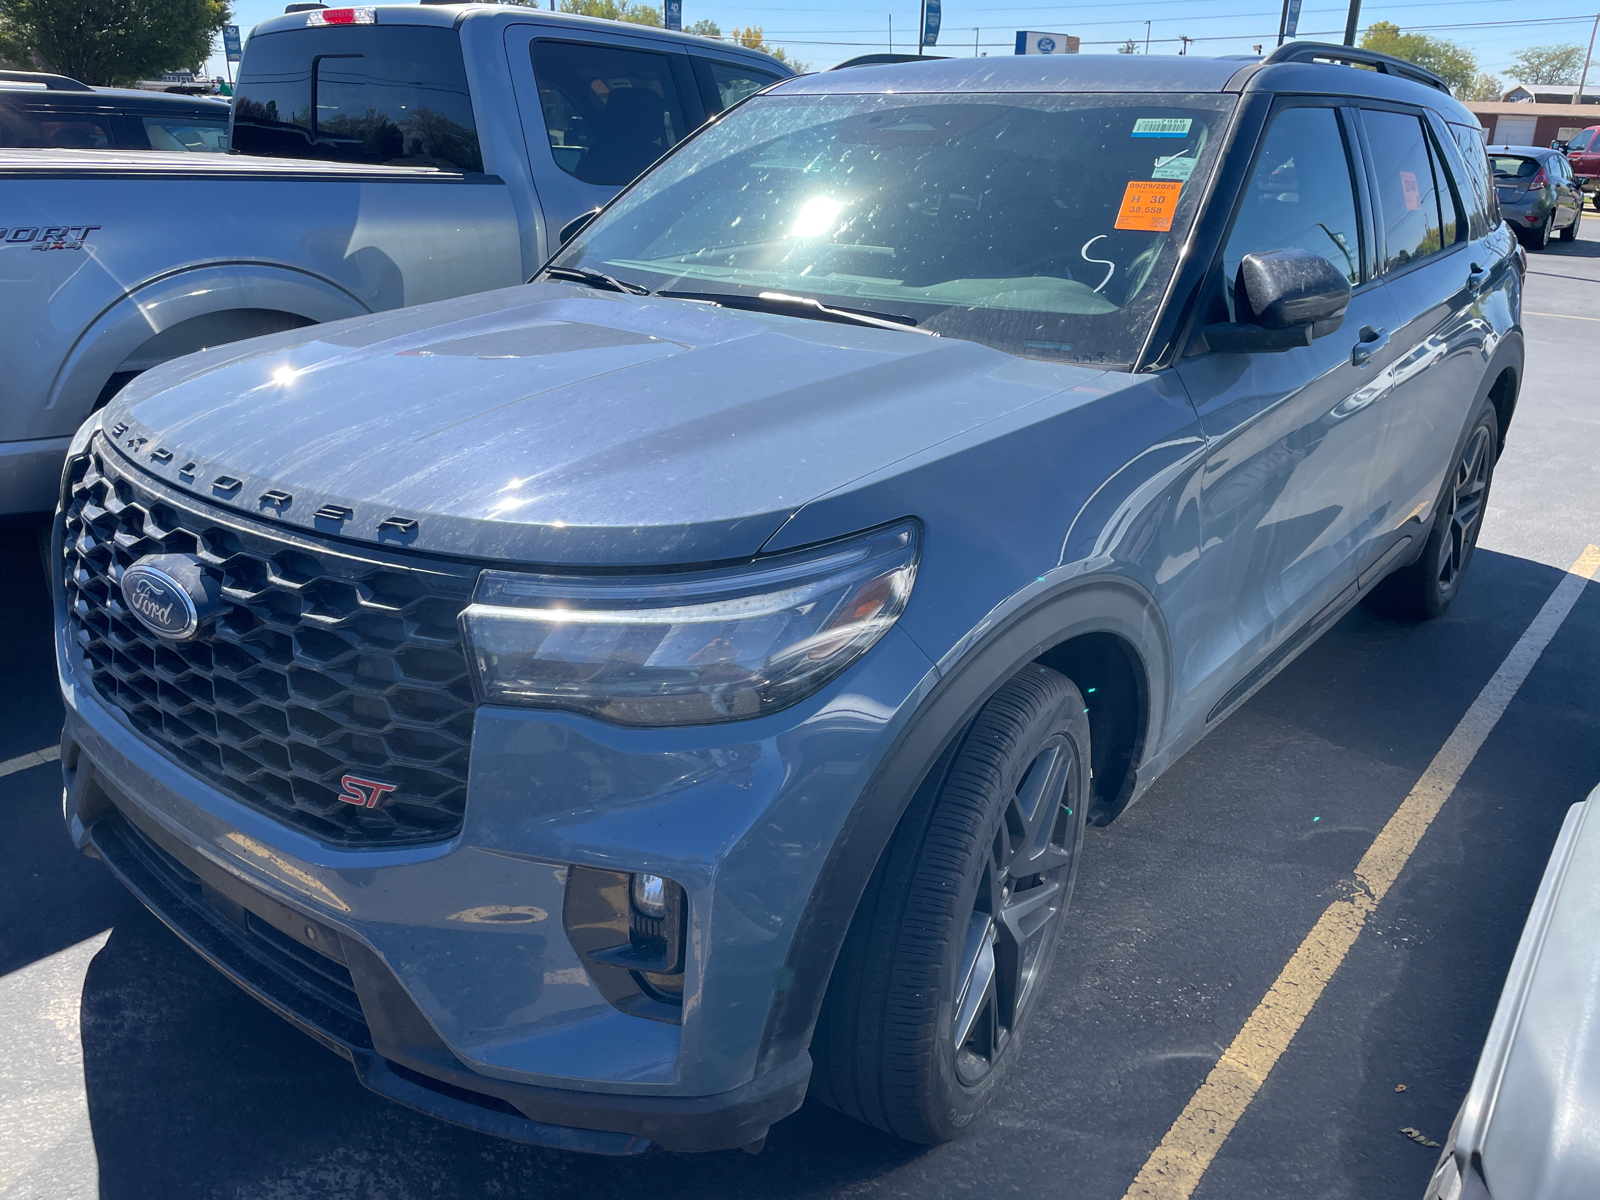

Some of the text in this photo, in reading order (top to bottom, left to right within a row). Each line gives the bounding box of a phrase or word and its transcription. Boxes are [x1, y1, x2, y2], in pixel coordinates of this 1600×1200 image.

[1131, 195, 1165, 204] H 30
[111, 421, 419, 536] EXPLORER
[131, 578, 173, 626] Ford
[338, 774, 398, 808] ST
